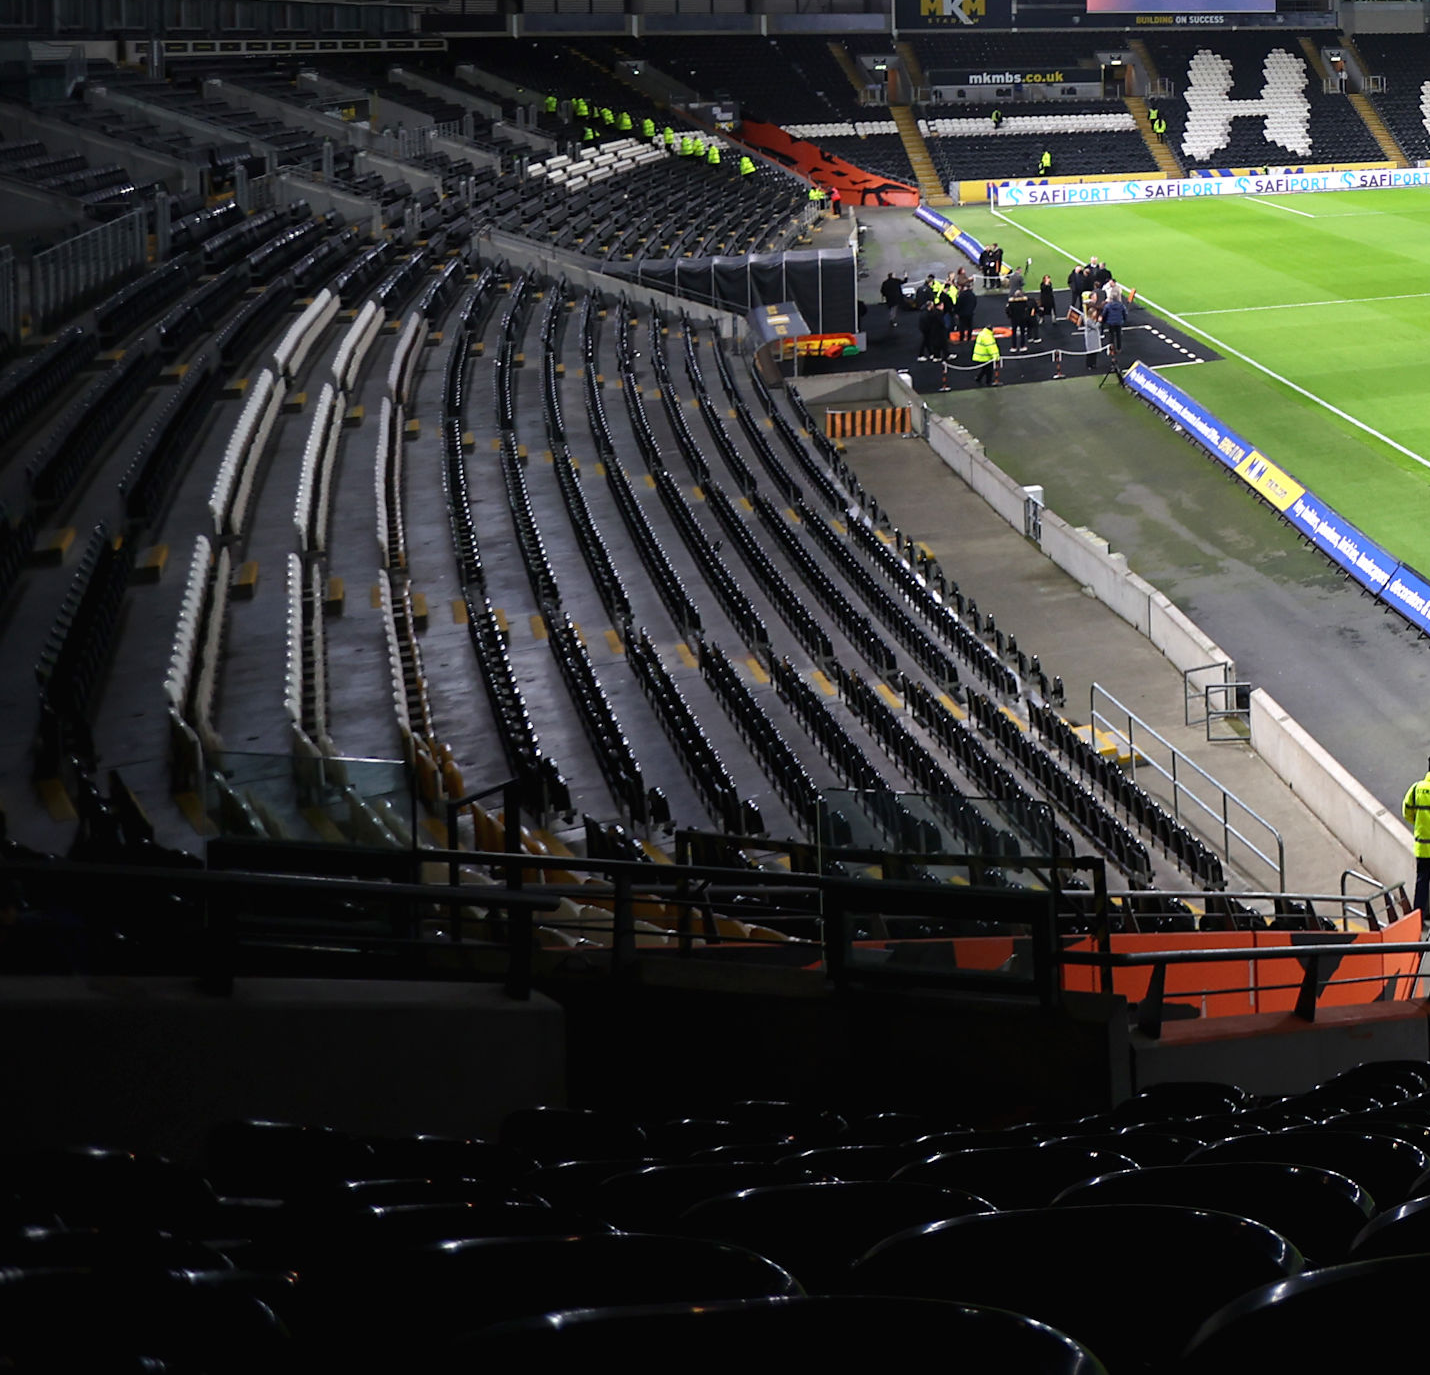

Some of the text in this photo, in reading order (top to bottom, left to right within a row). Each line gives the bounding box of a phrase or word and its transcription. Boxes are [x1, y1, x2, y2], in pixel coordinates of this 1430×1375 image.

[1136, 15, 1224, 24] BUILDING ON SUCCESS
[969, 71, 1064, 84] mkmbs.co.uk
